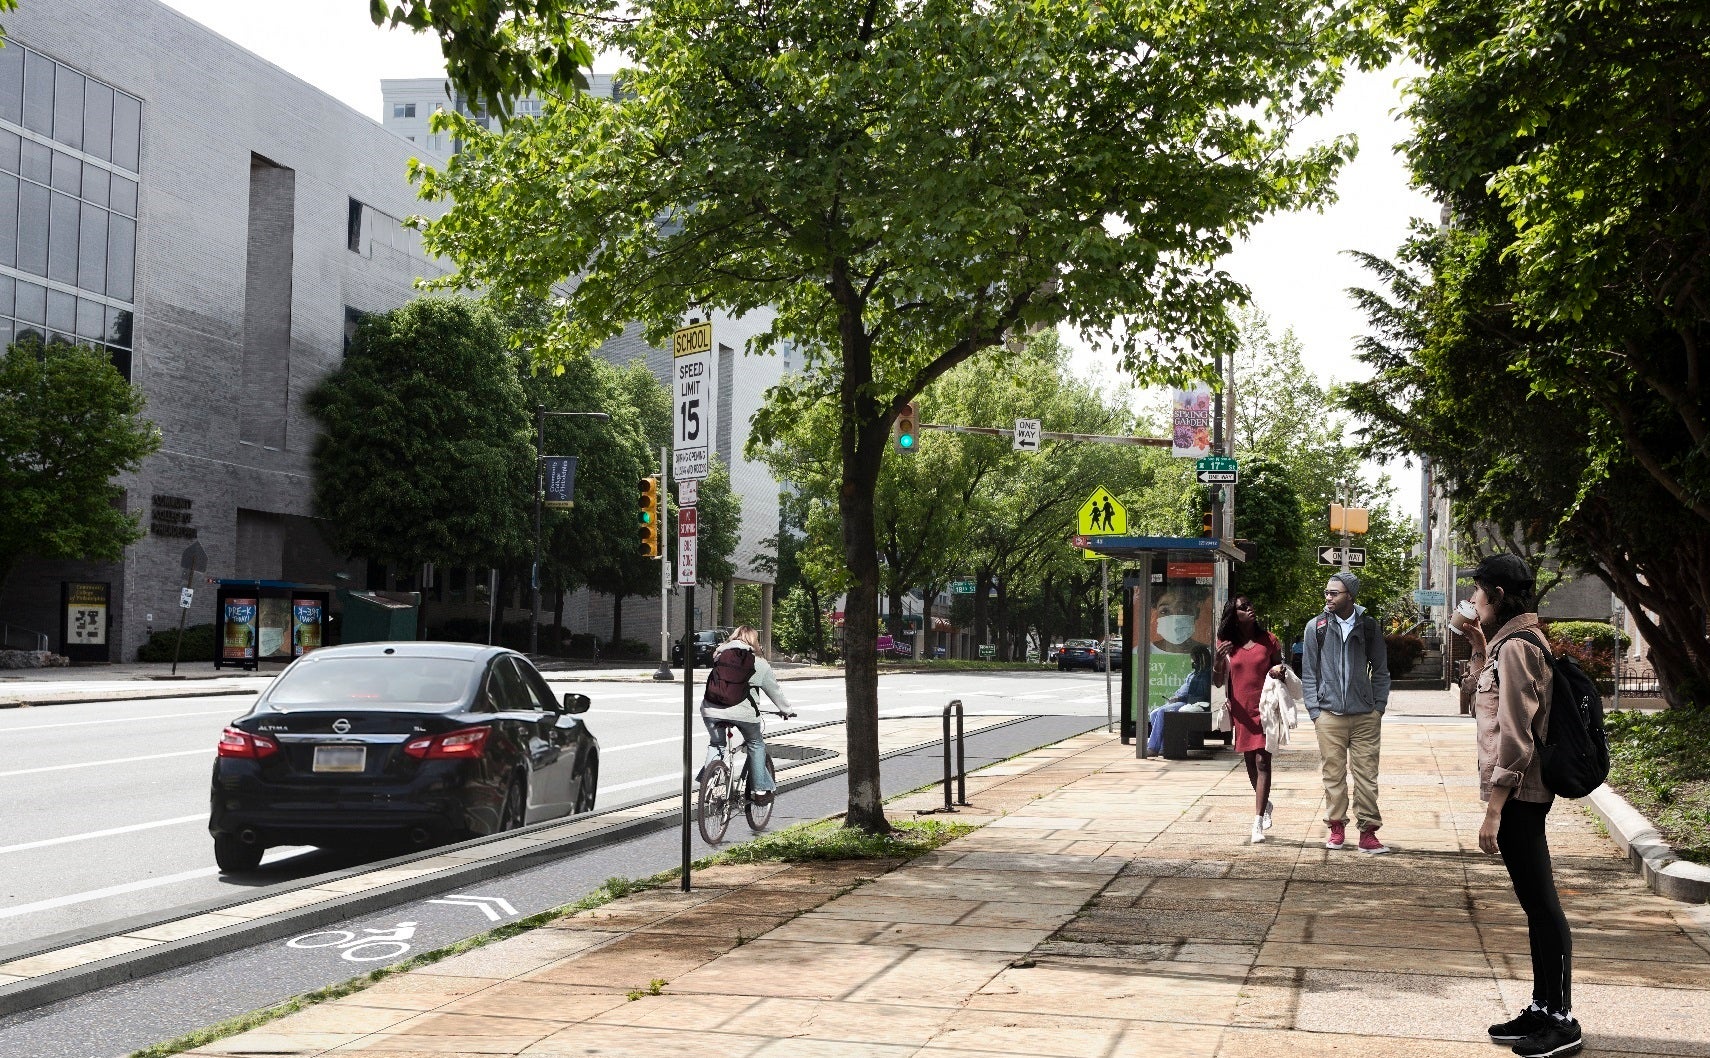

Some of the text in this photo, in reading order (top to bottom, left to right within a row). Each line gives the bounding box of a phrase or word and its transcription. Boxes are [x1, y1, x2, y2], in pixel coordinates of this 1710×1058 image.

[676, 328, 708, 353] SCHOOL
[680, 361, 704, 379] SPEED
[682, 380, 700, 397] LIMIT
[1174, 410, 1208, 419] SPRING
[681, 398, 700, 442] 15
[1174, 418, 1208, 427] GARDEN
[1020, 421, 1036, 430] ONE
[1018, 430, 1036, 438] WAY
[228, 606, 252, 617] PRE-K
[233, 615, 250, 623] TODAY!
